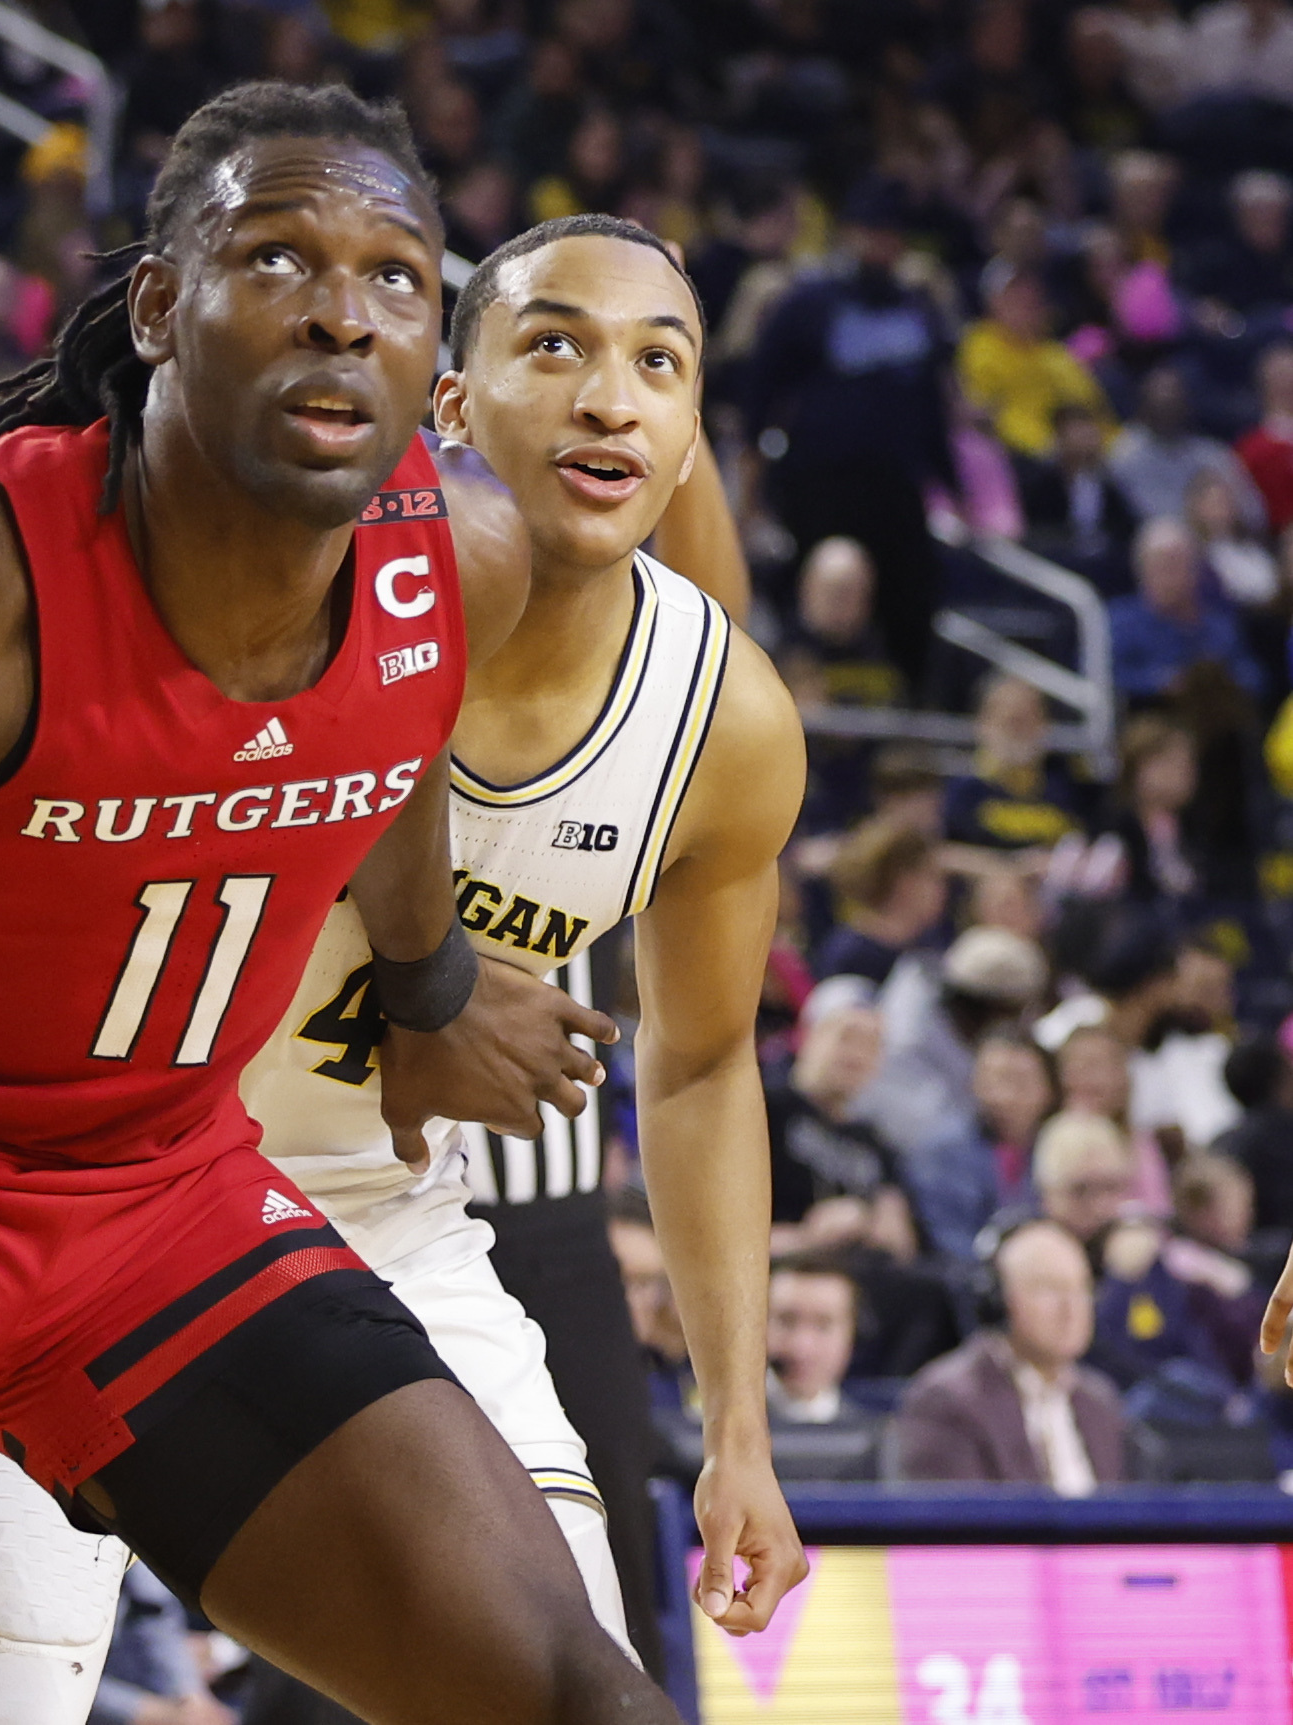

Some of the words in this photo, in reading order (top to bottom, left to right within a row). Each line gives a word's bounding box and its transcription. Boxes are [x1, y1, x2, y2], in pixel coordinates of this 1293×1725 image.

[373, 554, 436, 620] C
[232, 742, 294, 762] adidas
[19, 756, 424, 843] RUTGERS
[86, 872, 277, 1069] 11
